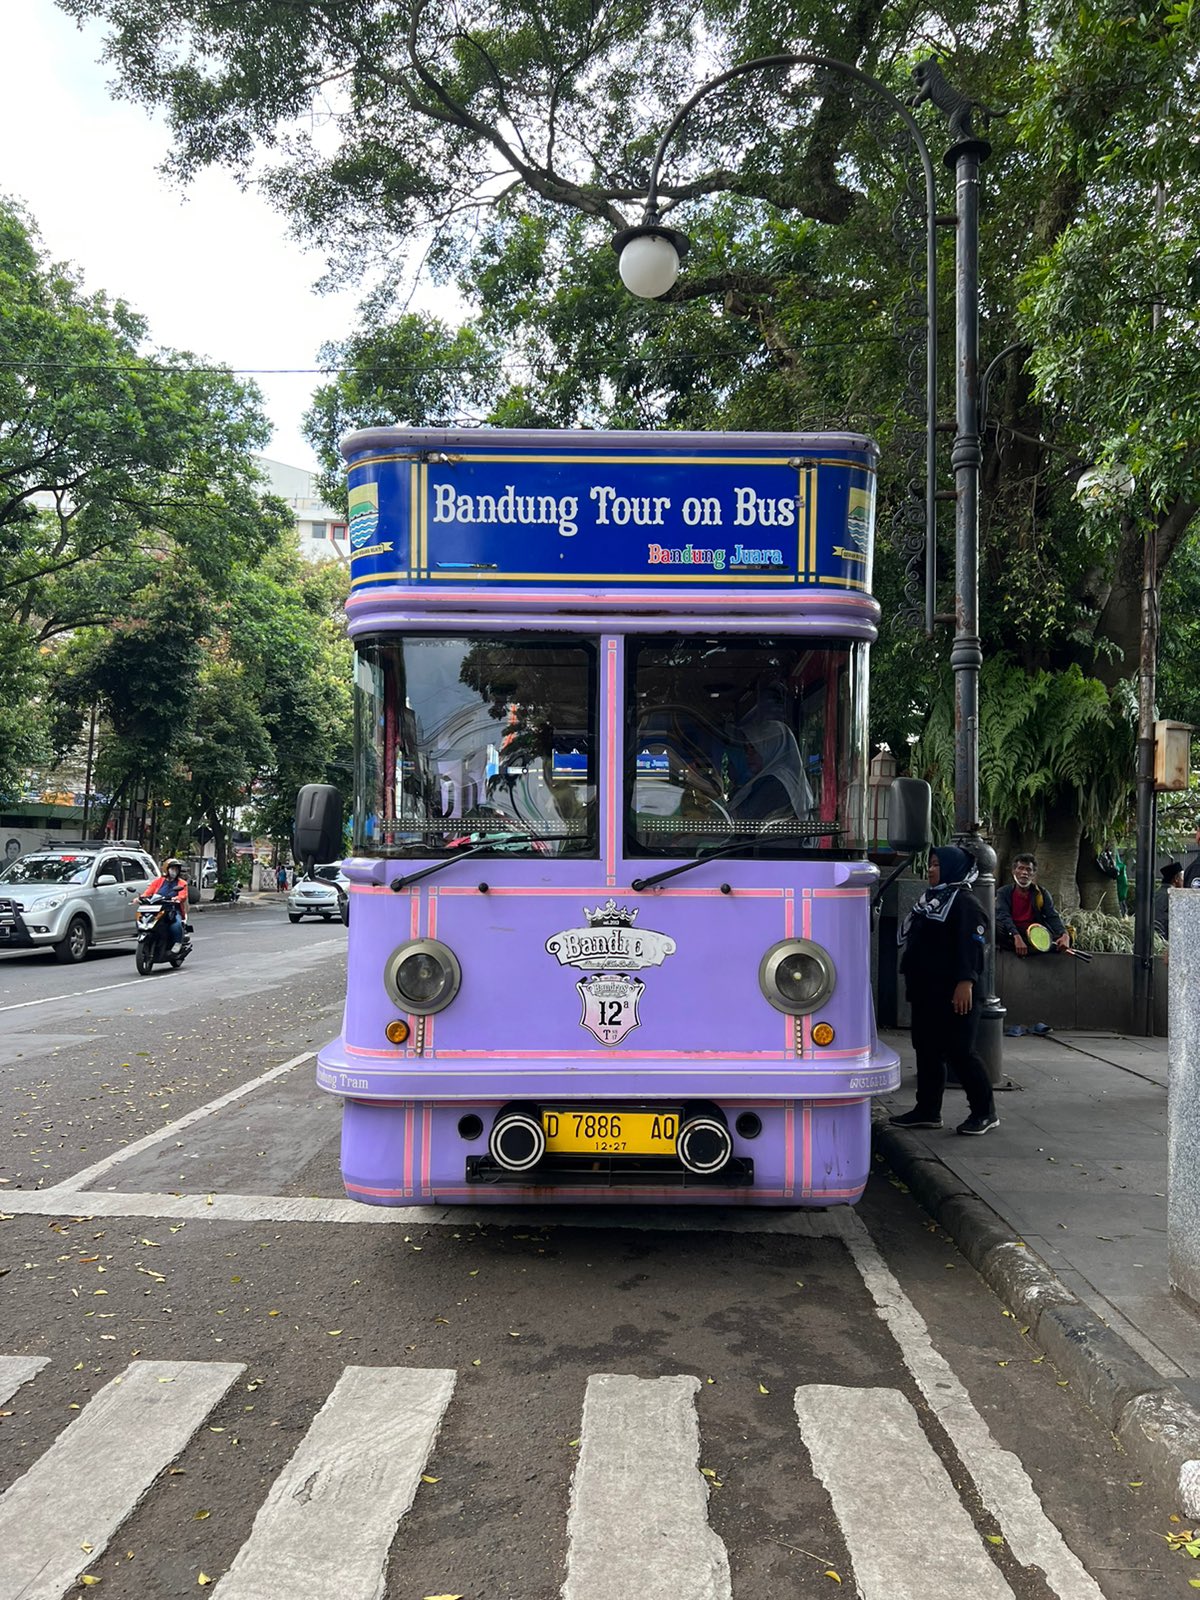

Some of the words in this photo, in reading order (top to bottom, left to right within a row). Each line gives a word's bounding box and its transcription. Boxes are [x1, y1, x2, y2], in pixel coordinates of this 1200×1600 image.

[433, 484, 578, 537] Bandung
[590, 486, 671, 526] Tour
[682, 497, 723, 526] on
[733, 487, 795, 526] Bus
[648, 543, 726, 570] Bandung
[730, 544, 784, 565] Juara
[598, 1001, 622, 1026] 12
[339, 1073, 369, 1090] Tram
[545, 1114, 559, 1138] D
[572, 1115, 622, 1138] 7886
[651, 1116, 675, 1140] AQ
